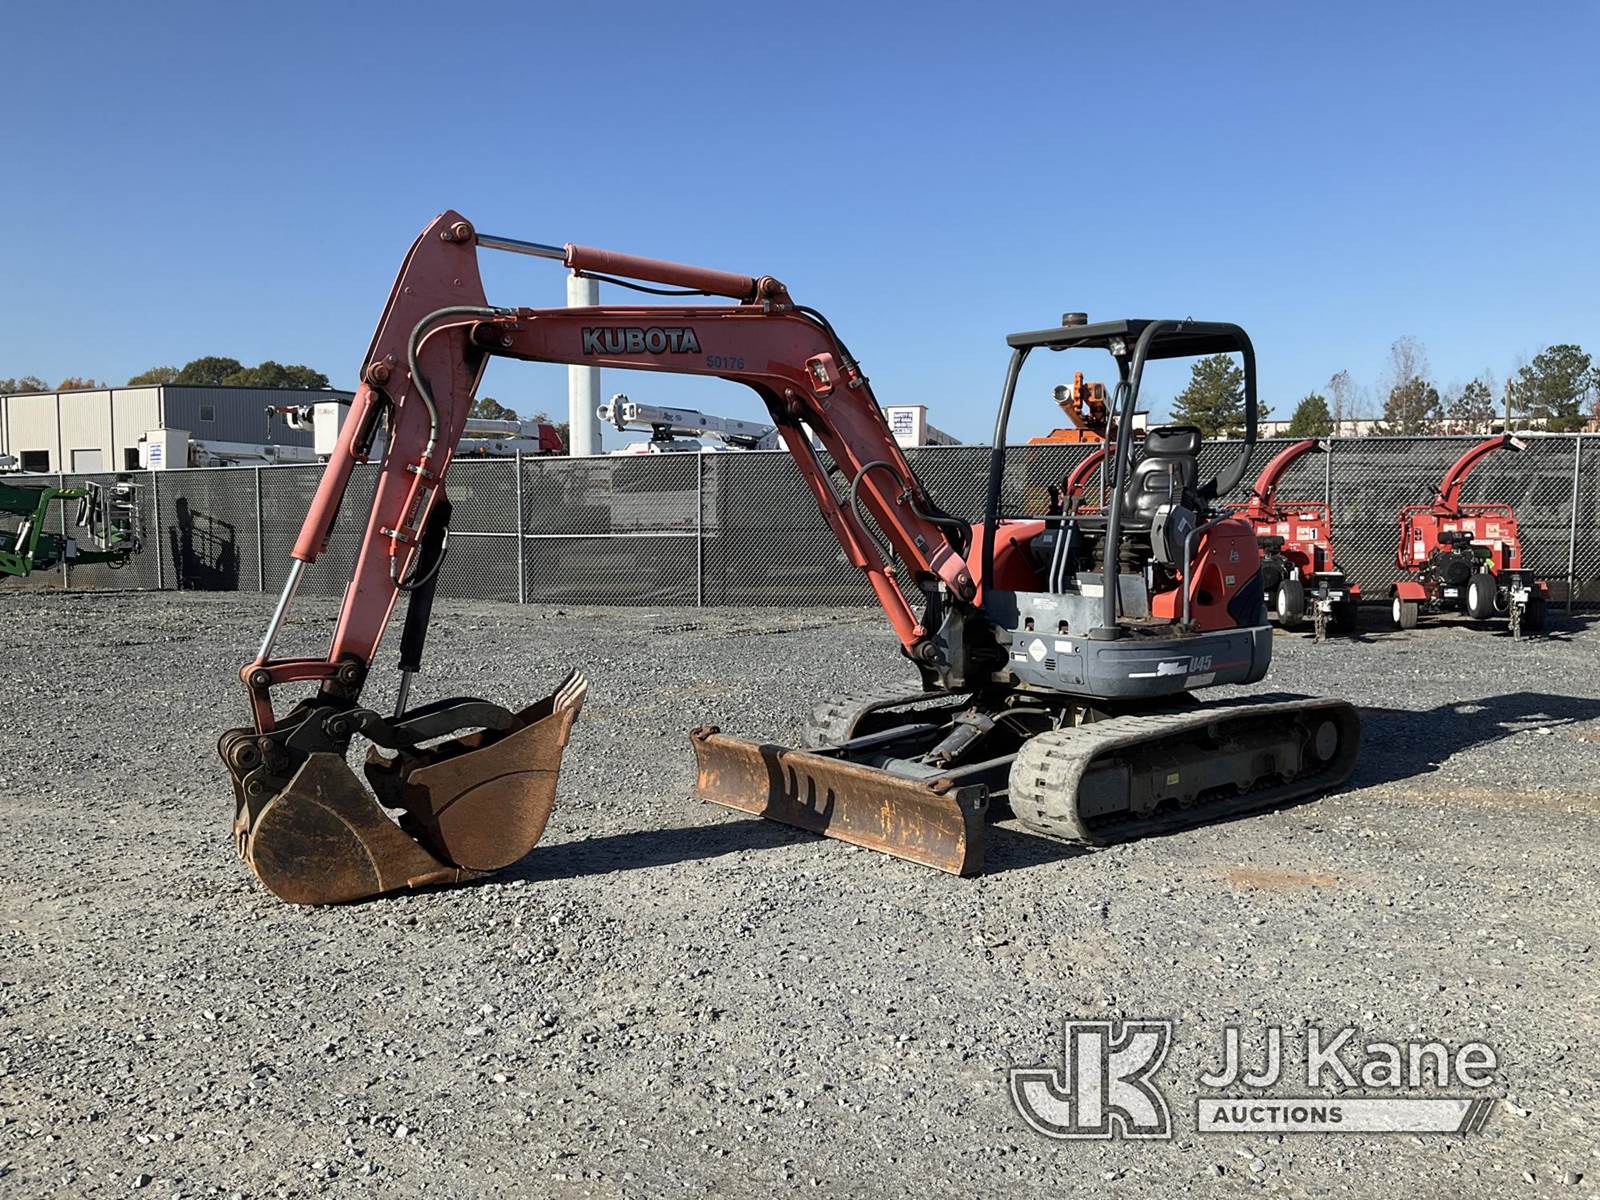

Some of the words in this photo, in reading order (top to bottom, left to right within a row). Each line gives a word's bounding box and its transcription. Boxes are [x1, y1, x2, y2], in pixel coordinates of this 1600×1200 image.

[582, 326, 702, 355] KUBOTA
[706, 355, 745, 370] 50176
[1189, 655, 1212, 672] U45
